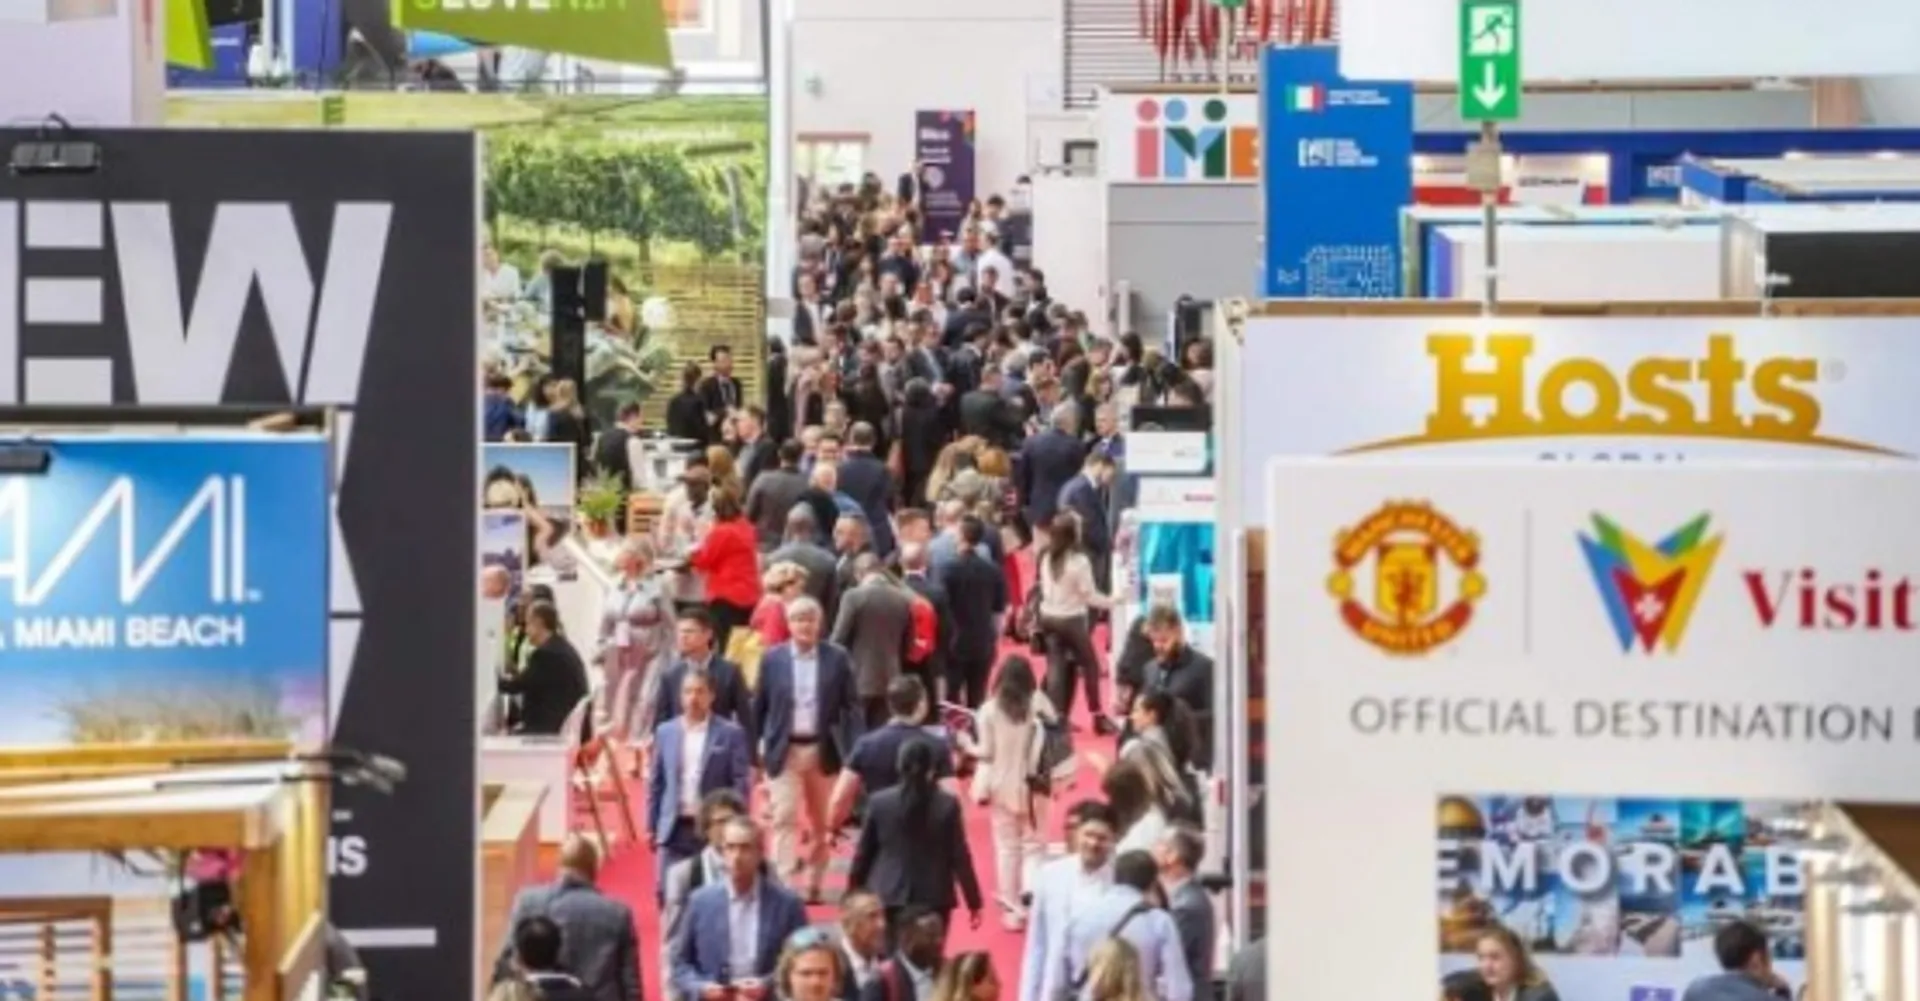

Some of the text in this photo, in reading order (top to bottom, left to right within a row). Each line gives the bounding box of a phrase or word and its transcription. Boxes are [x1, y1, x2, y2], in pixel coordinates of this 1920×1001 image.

[0, 201, 394, 406] EW
[1426, 333, 1822, 437] Hosts
[15, 616, 116, 648] MIAMI
[125, 614, 246, 648] BEACH
[1744, 567, 1920, 632] Visit
[1350, 697, 1556, 738] OFFICIAL
[1574, 698, 1894, 743] DESTINATION
